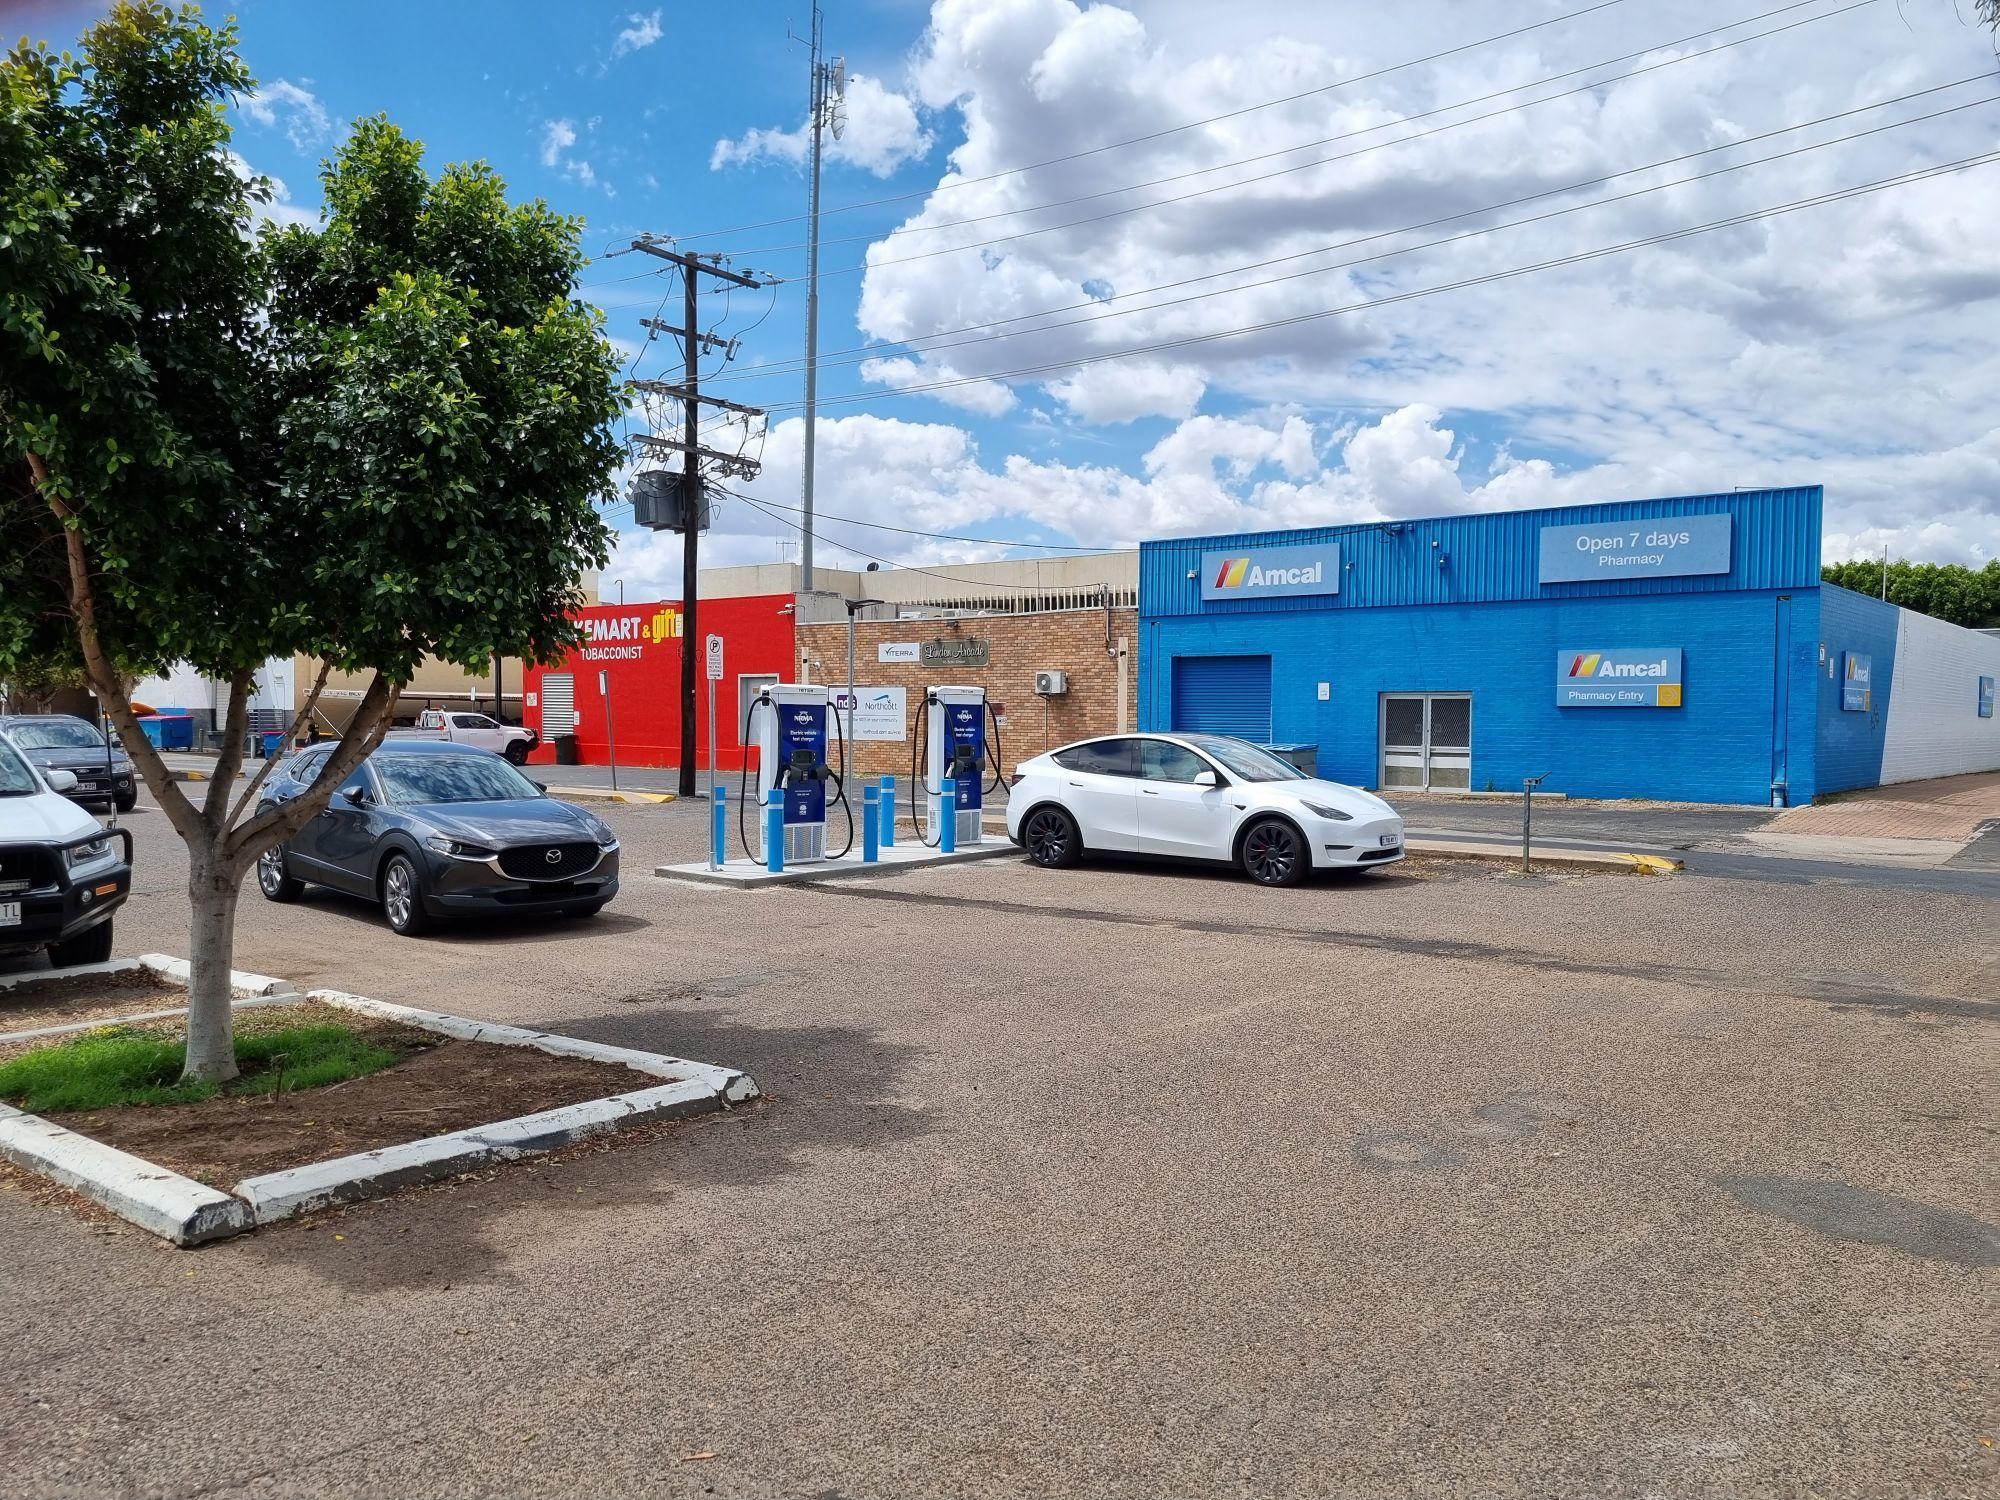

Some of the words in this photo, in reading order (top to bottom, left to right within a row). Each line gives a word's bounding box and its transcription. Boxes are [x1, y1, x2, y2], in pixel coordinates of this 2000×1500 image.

[1576, 535, 1623, 553] Open
[1629, 533, 1640, 547] 7
[1645, 531, 1690, 549] days
[1599, 554, 1664, 567] Pharmacy
[1247, 562, 1322, 587] Amcal
[642, 624, 651, 639] &
[580, 646, 643, 661] TOBACCONIST
[885, 646, 914, 657] VITERRA
[1598, 659, 1668, 677] Amcal
[1568, 691, 1616, 702] Pharmacy
[1618, 691, 1644, 702] Entry
[865, 702, 898, 711] Northcott
